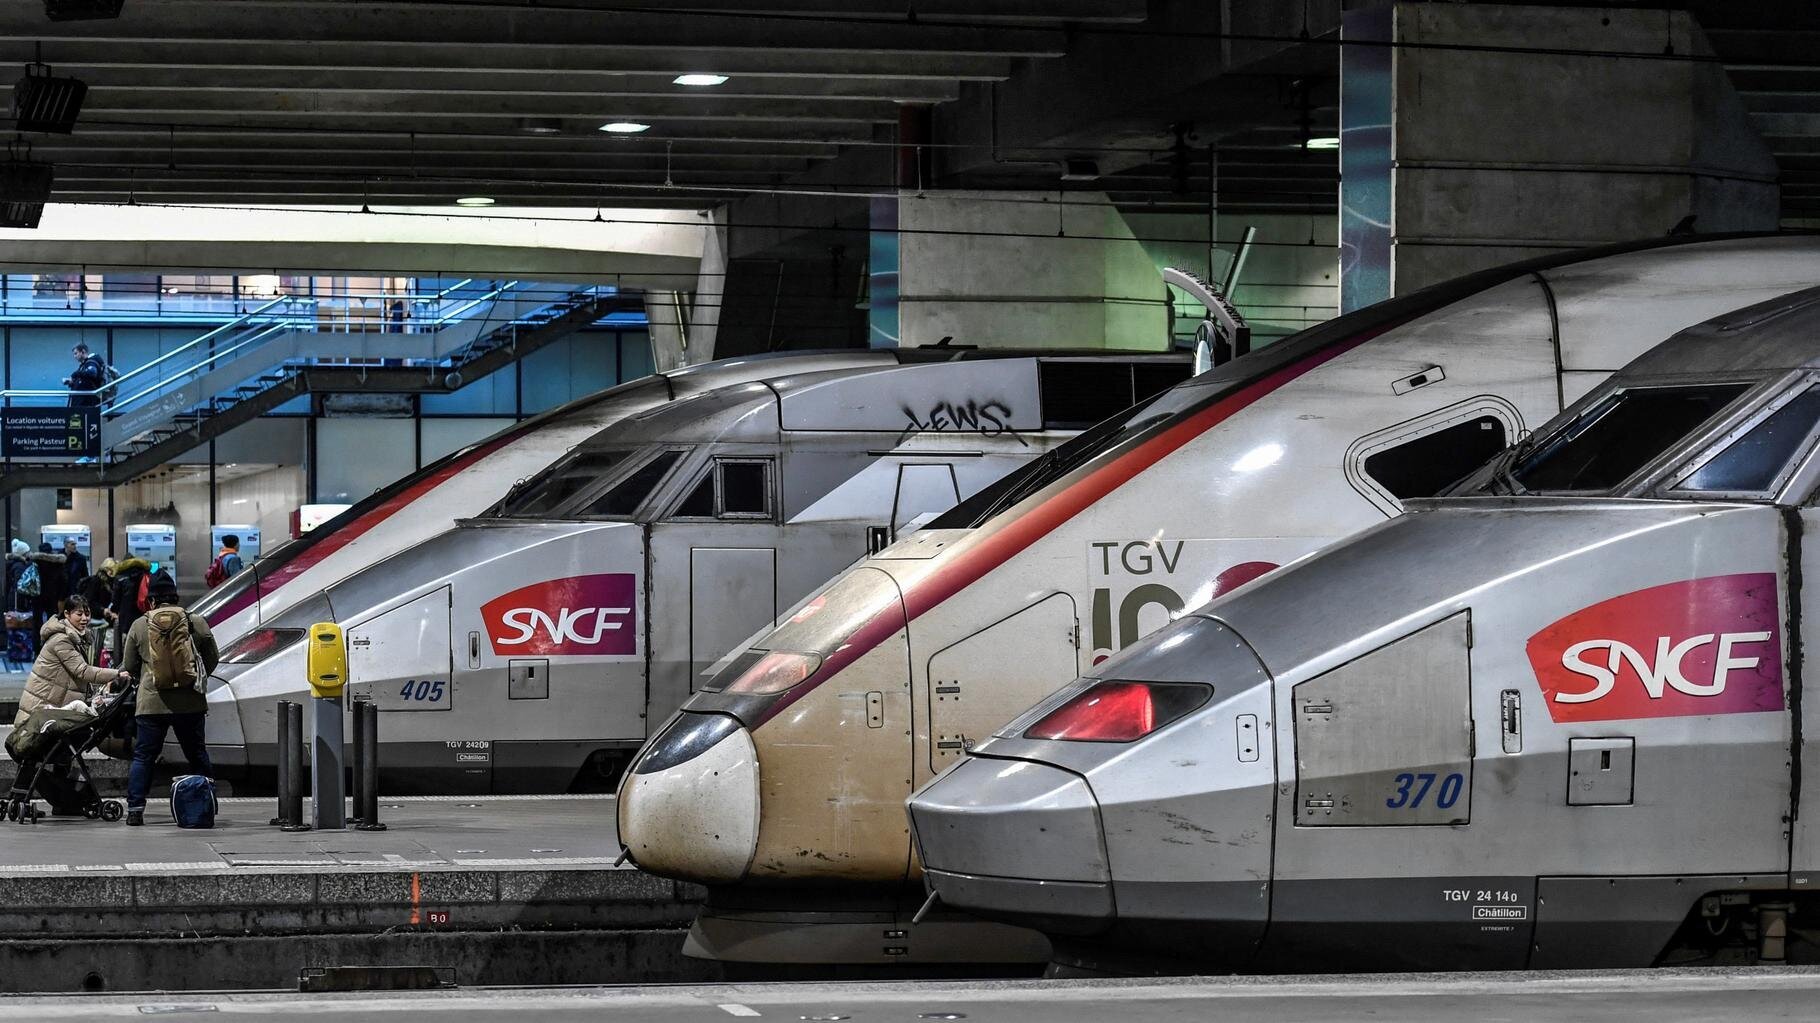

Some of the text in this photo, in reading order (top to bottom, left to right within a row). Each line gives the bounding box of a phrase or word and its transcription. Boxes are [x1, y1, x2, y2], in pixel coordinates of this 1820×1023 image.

[6, 416, 66, 424] Location voitures
[12, 437, 66, 446] Parking Pasteur
[1092, 540, 1185, 575] TGV
[497, 607, 631, 646] SNCF
[1555, 631, 1772, 704] SNCF
[400, 680, 445, 702] 405
[1386, 773, 1464, 809] 370
[1443, 890, 1471, 901] TGV
[1477, 908, 1522, 917] Châtillon
